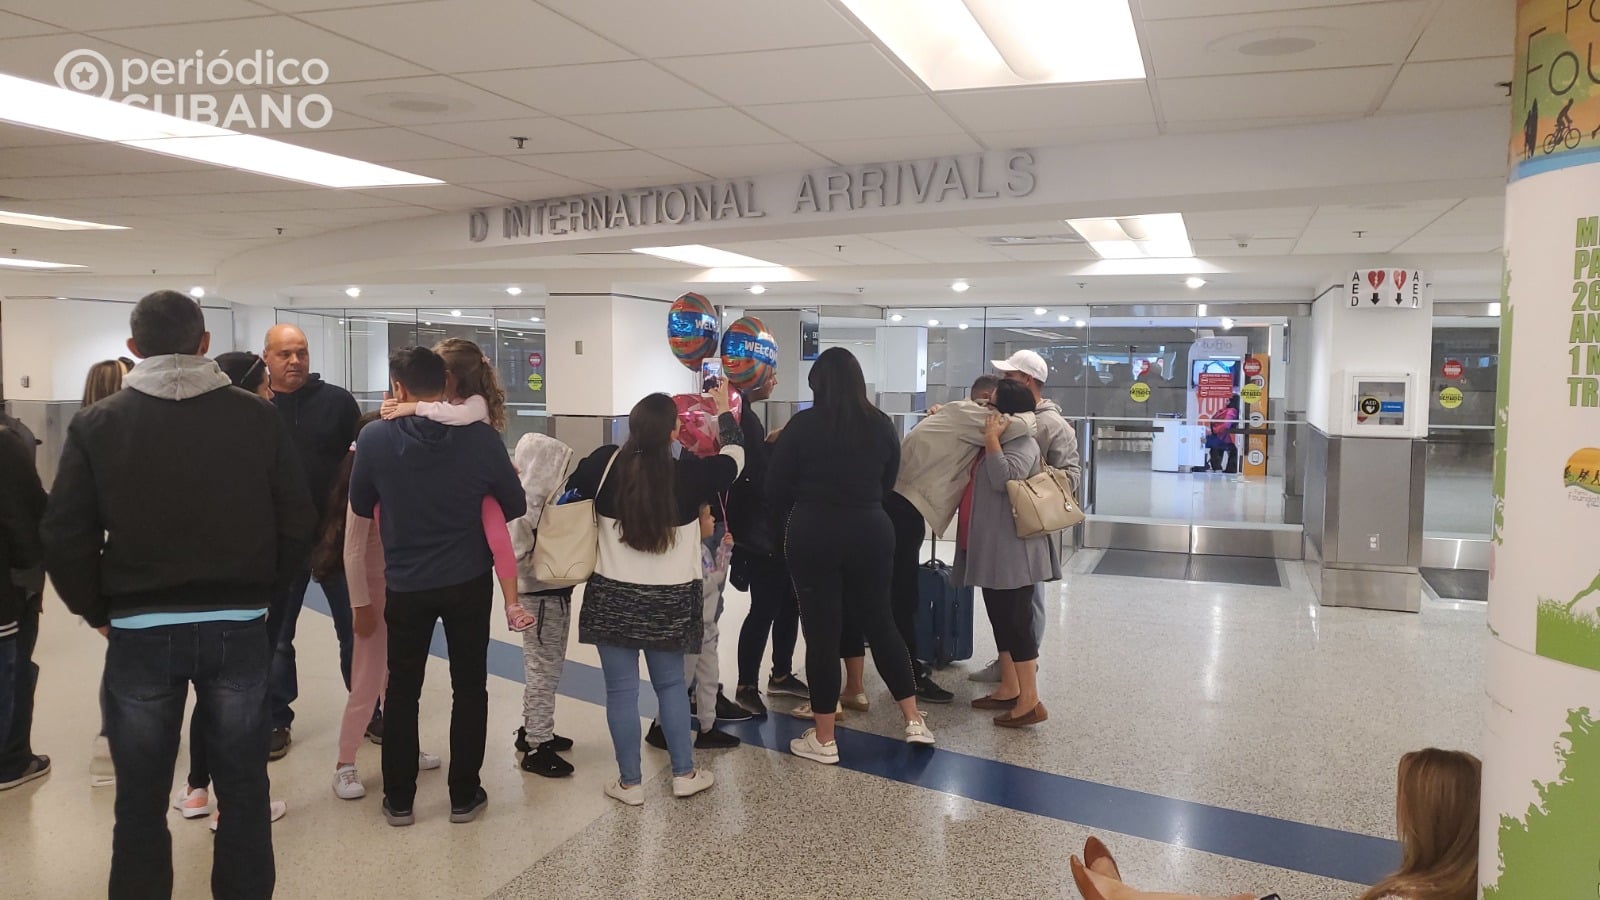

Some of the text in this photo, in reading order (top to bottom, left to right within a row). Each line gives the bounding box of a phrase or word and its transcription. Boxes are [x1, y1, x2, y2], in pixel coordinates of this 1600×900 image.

[469, 151, 1036, 242] D INTERNATIONAL ARRIVALS
[1576, 215, 1600, 248] M
[1351, 271, 1361, 307] AED
[1571, 280, 1600, 312] 26
[1568, 345, 1580, 375] 1
[1567, 377, 1600, 407] TR
